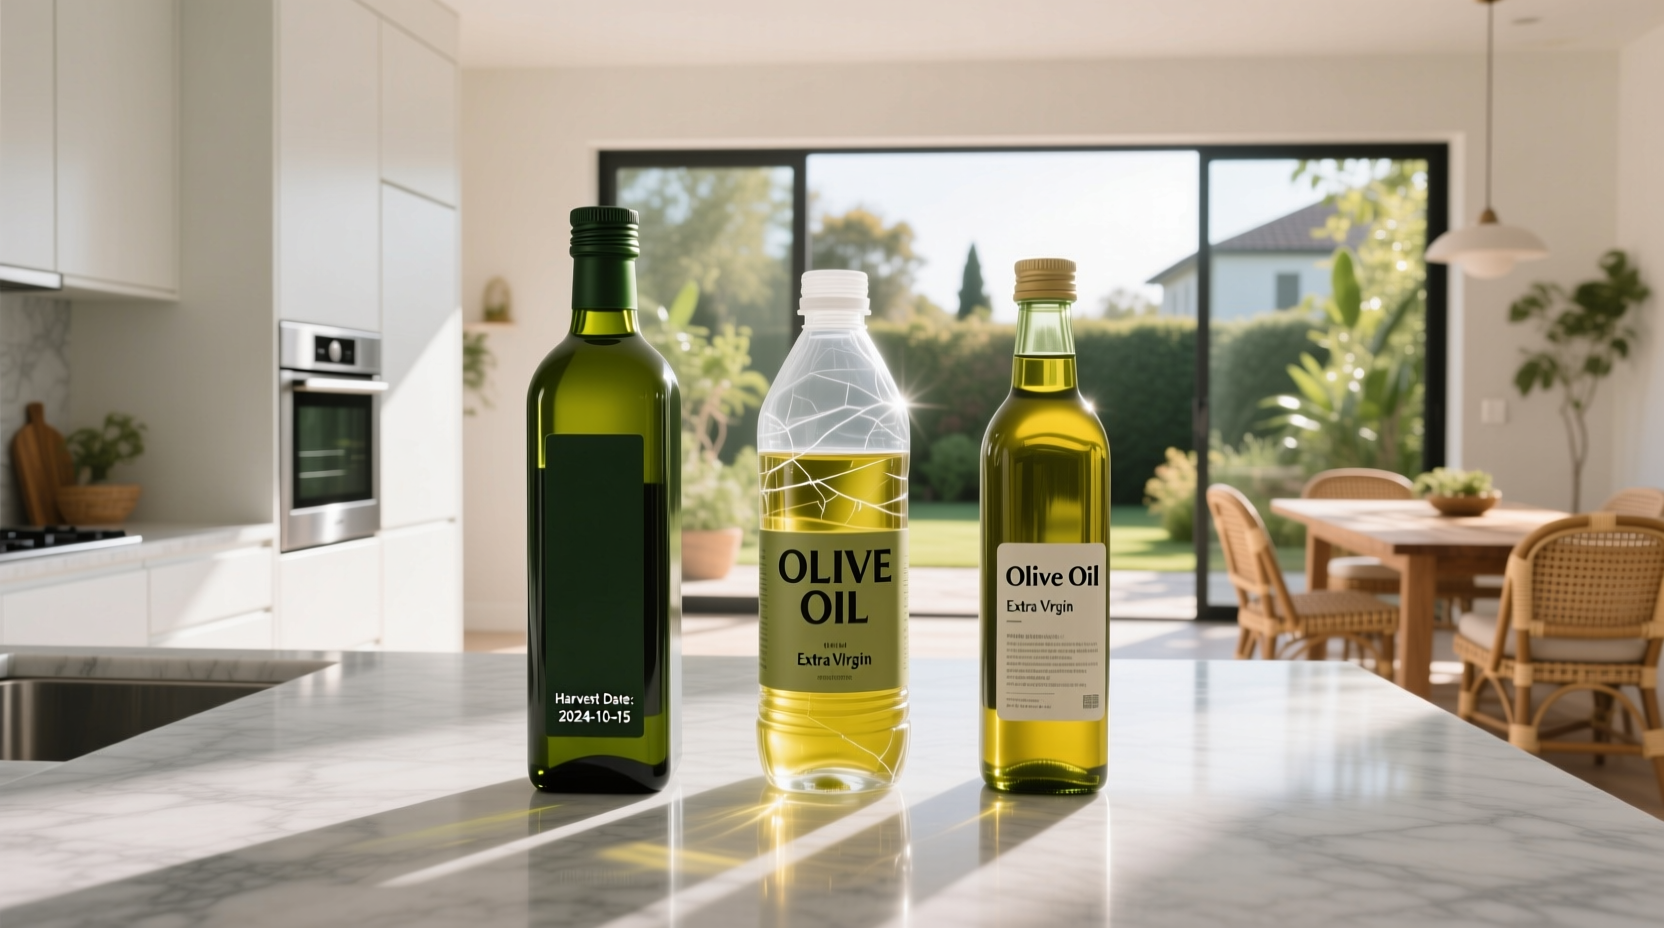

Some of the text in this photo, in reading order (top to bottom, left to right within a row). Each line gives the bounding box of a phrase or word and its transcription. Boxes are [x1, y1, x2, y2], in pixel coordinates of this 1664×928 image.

[778, 548, 892, 584] OLIVE
[1005, 564, 1099, 587] Olive Oil
[800, 589, 869, 625] OIL
[1006, 599, 1037, 613] Extra
[797, 652, 831, 667] Extra
[555, 692, 600, 705] Harvest
[558, 709, 631, 724] 2024-10-15
